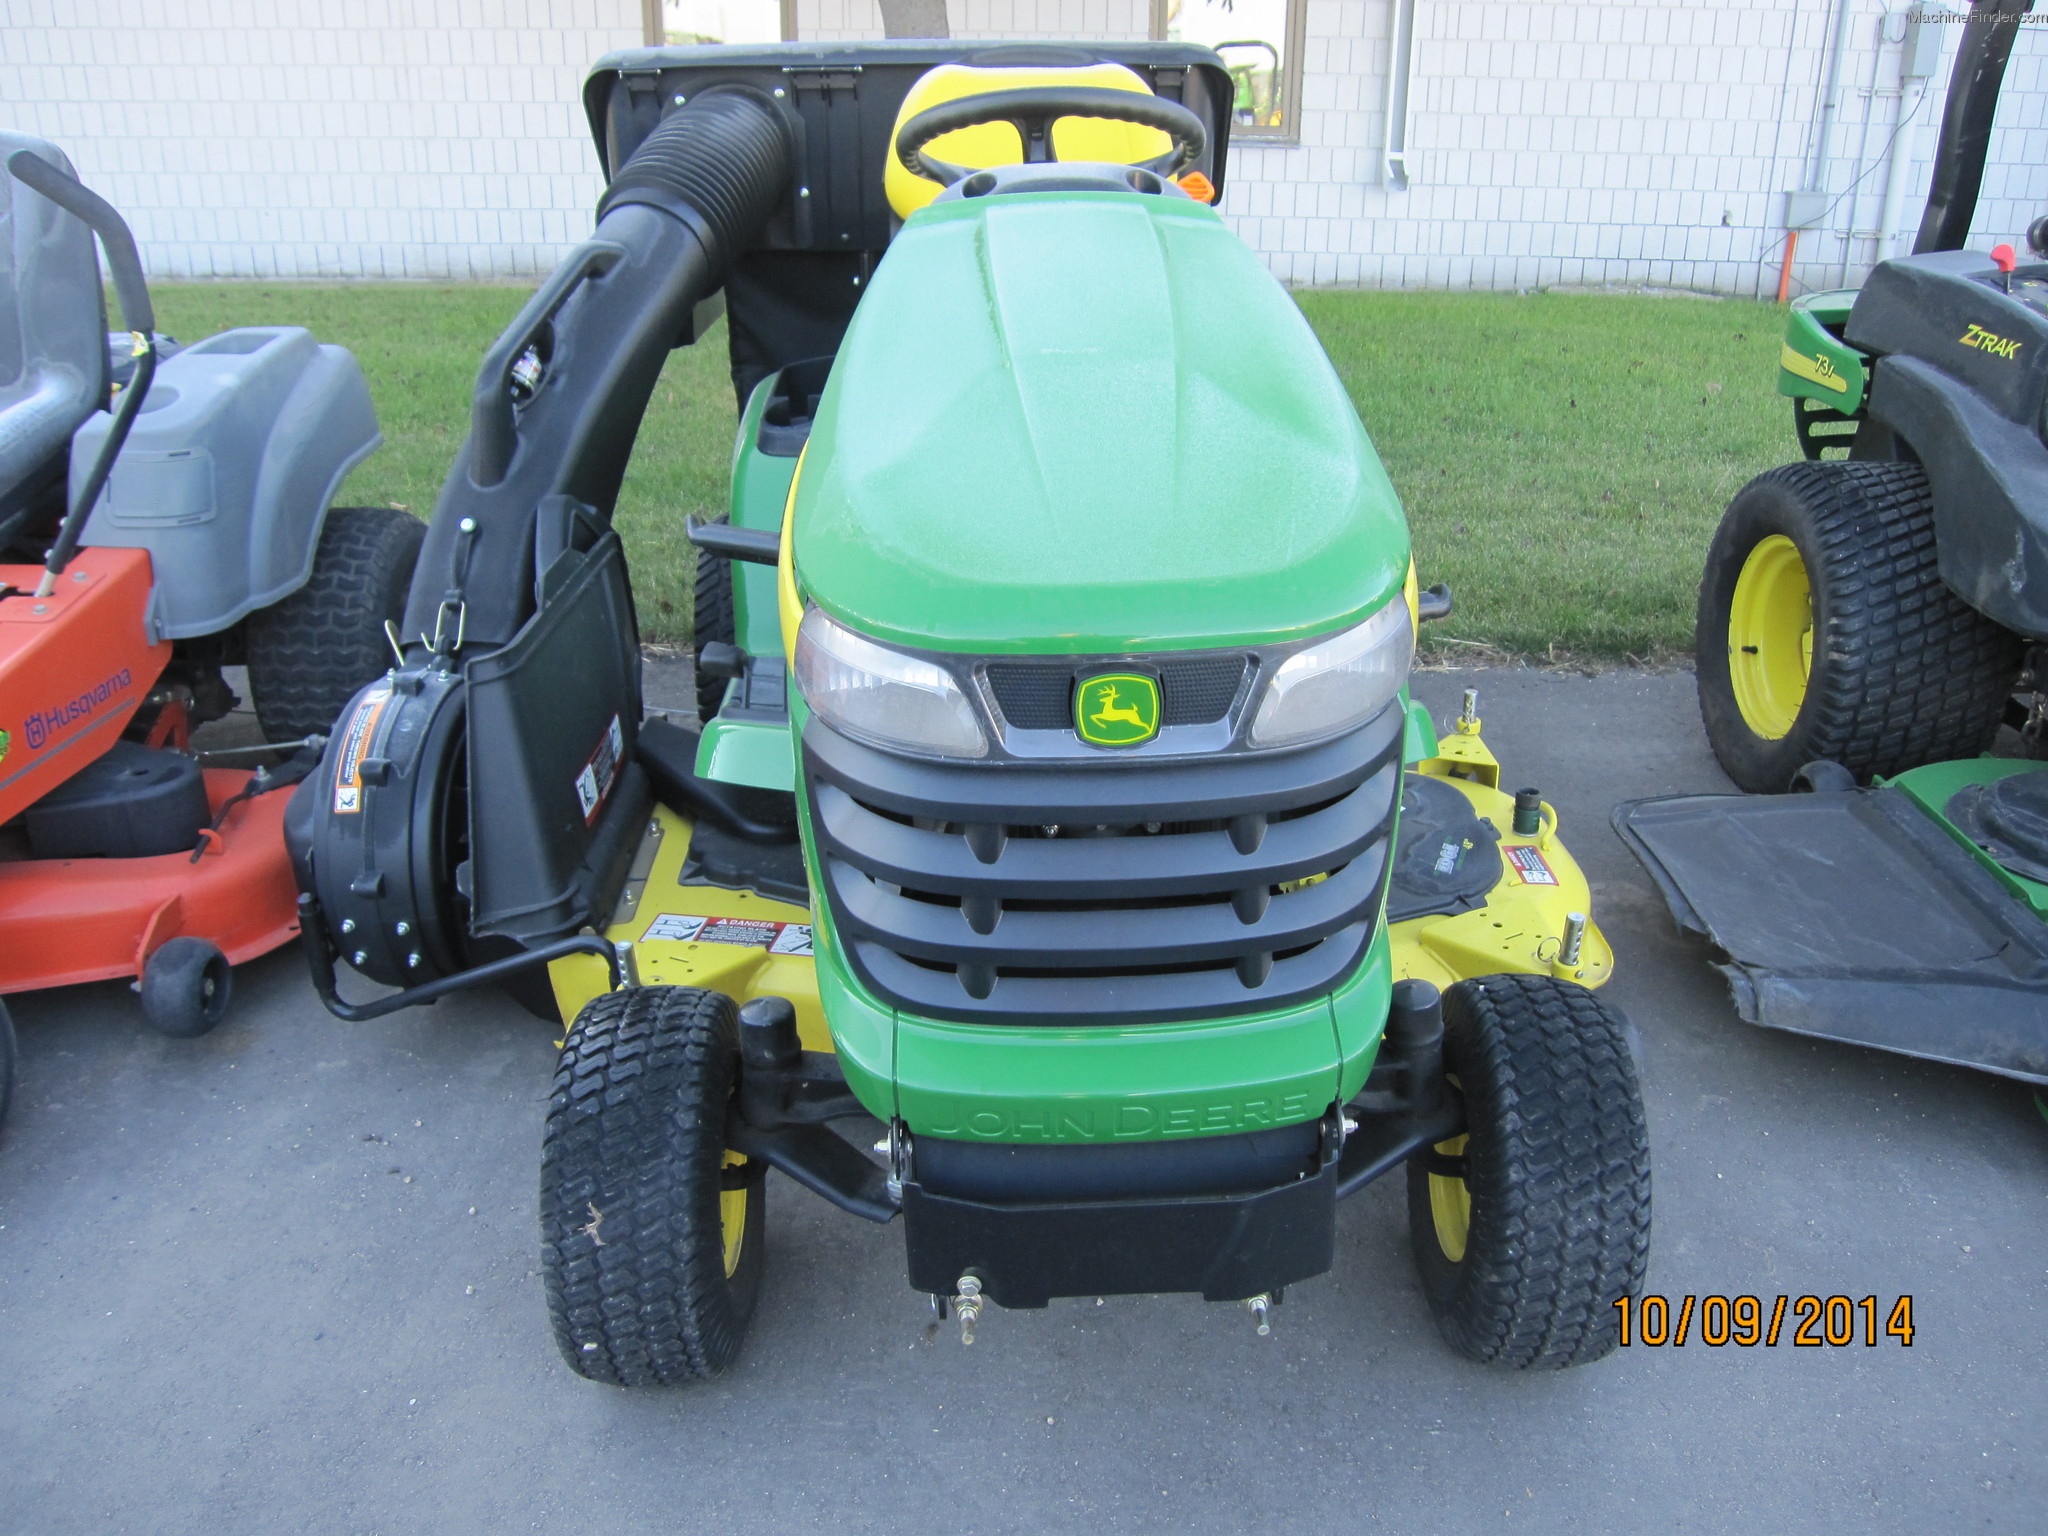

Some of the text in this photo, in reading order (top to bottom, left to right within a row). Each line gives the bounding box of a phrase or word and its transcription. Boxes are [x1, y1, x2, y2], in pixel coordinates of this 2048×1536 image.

[1959, 323, 2023, 360] ZTRAK
[45, 668, 132, 734] Husqvarna
[358, 728, 372, 760] WARNING
[729, 919, 775, 929] DANGER
[931, 1091, 1308, 1138] JOHN DEERE
